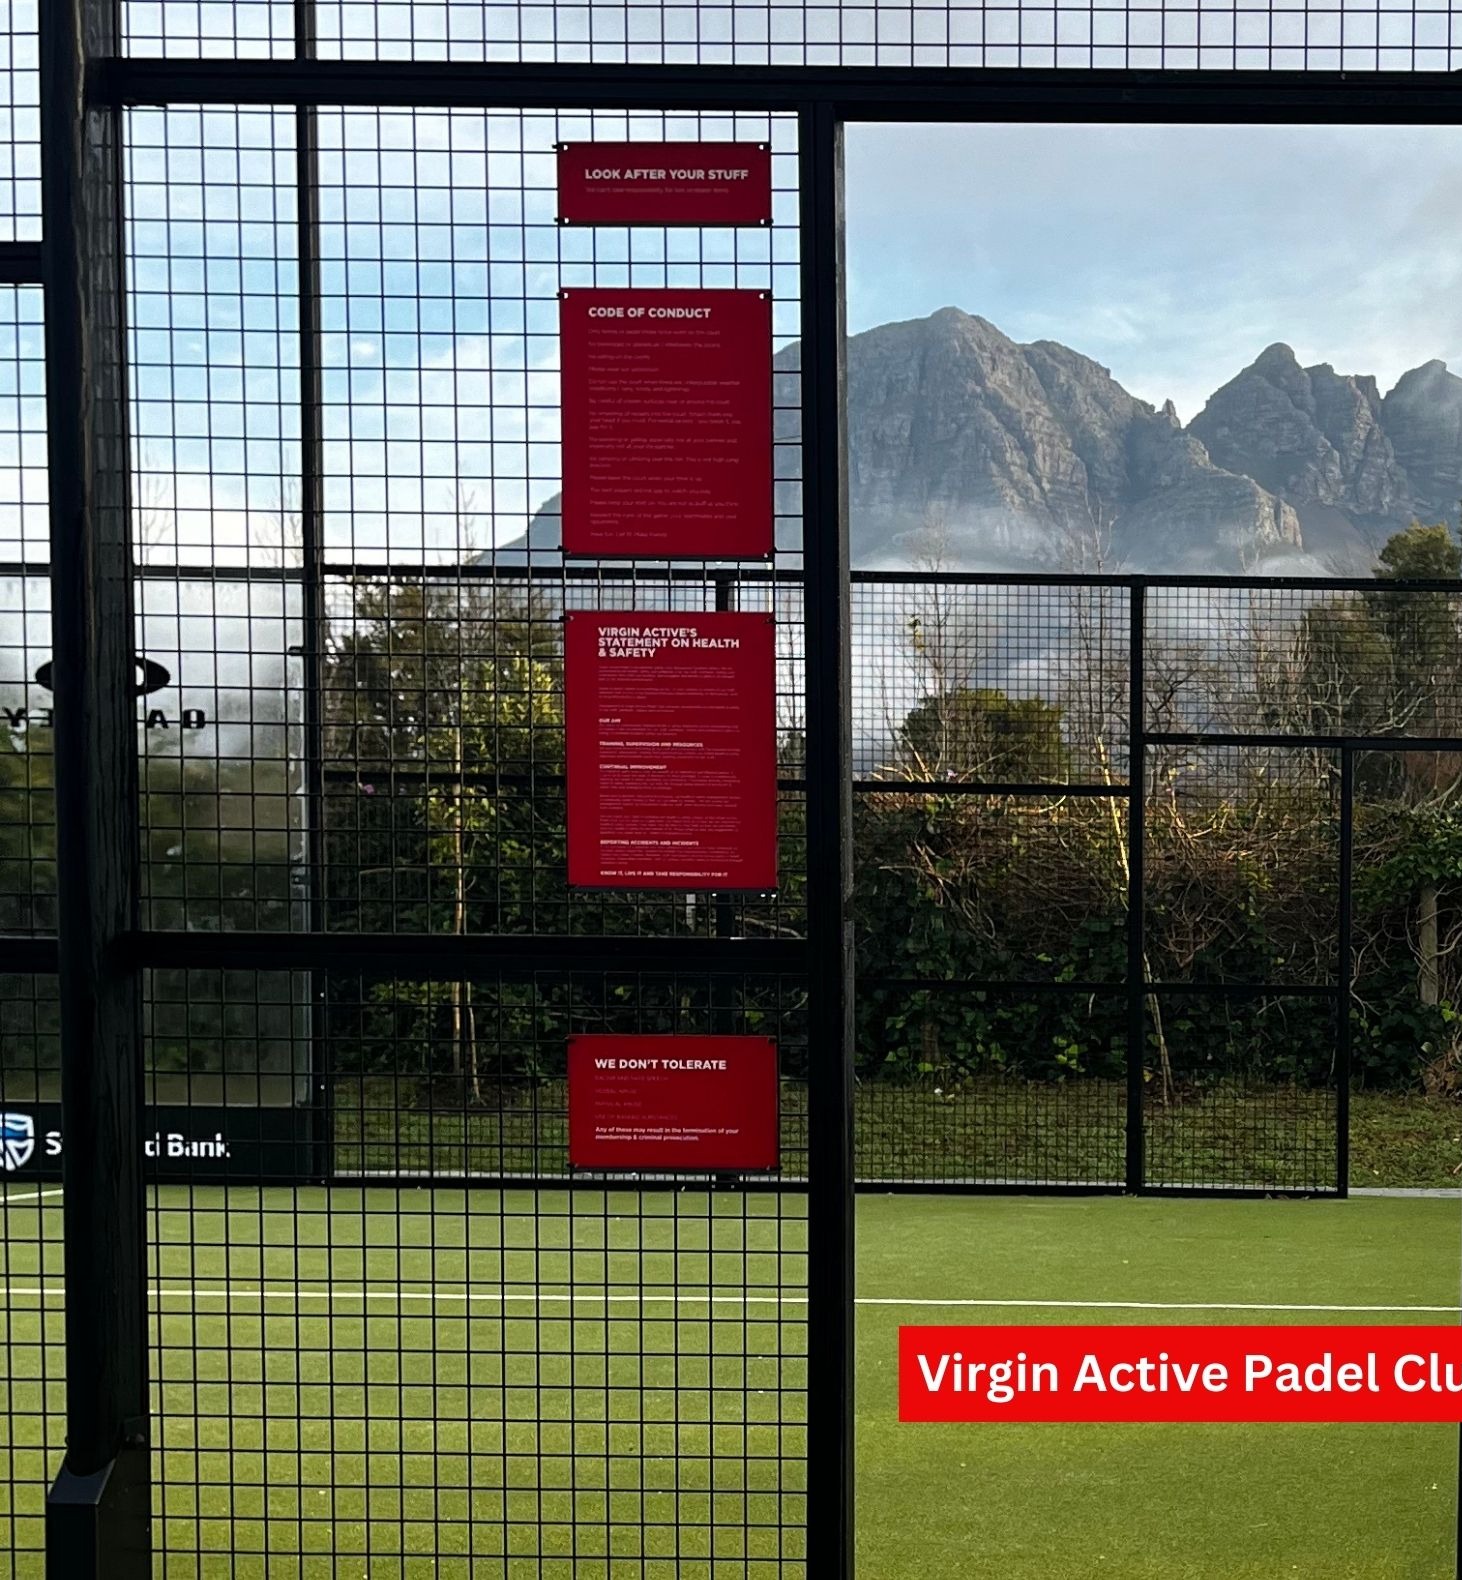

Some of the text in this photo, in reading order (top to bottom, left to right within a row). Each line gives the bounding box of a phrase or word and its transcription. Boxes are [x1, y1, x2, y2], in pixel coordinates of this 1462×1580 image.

[585, 169, 749, 180] LOOK AFTER YOUR STUFF
[588, 307, 711, 318] CODE OF CONDUCT
[598, 627, 640, 637] VIRGIN
[598, 637, 739, 648] STATEMENT ON HEALTH
[609, 648, 656, 657] SAFETY
[595, 1058, 726, 1070] WE DON'T TOLERATE
[167, 1133, 230, 1157] Bank
